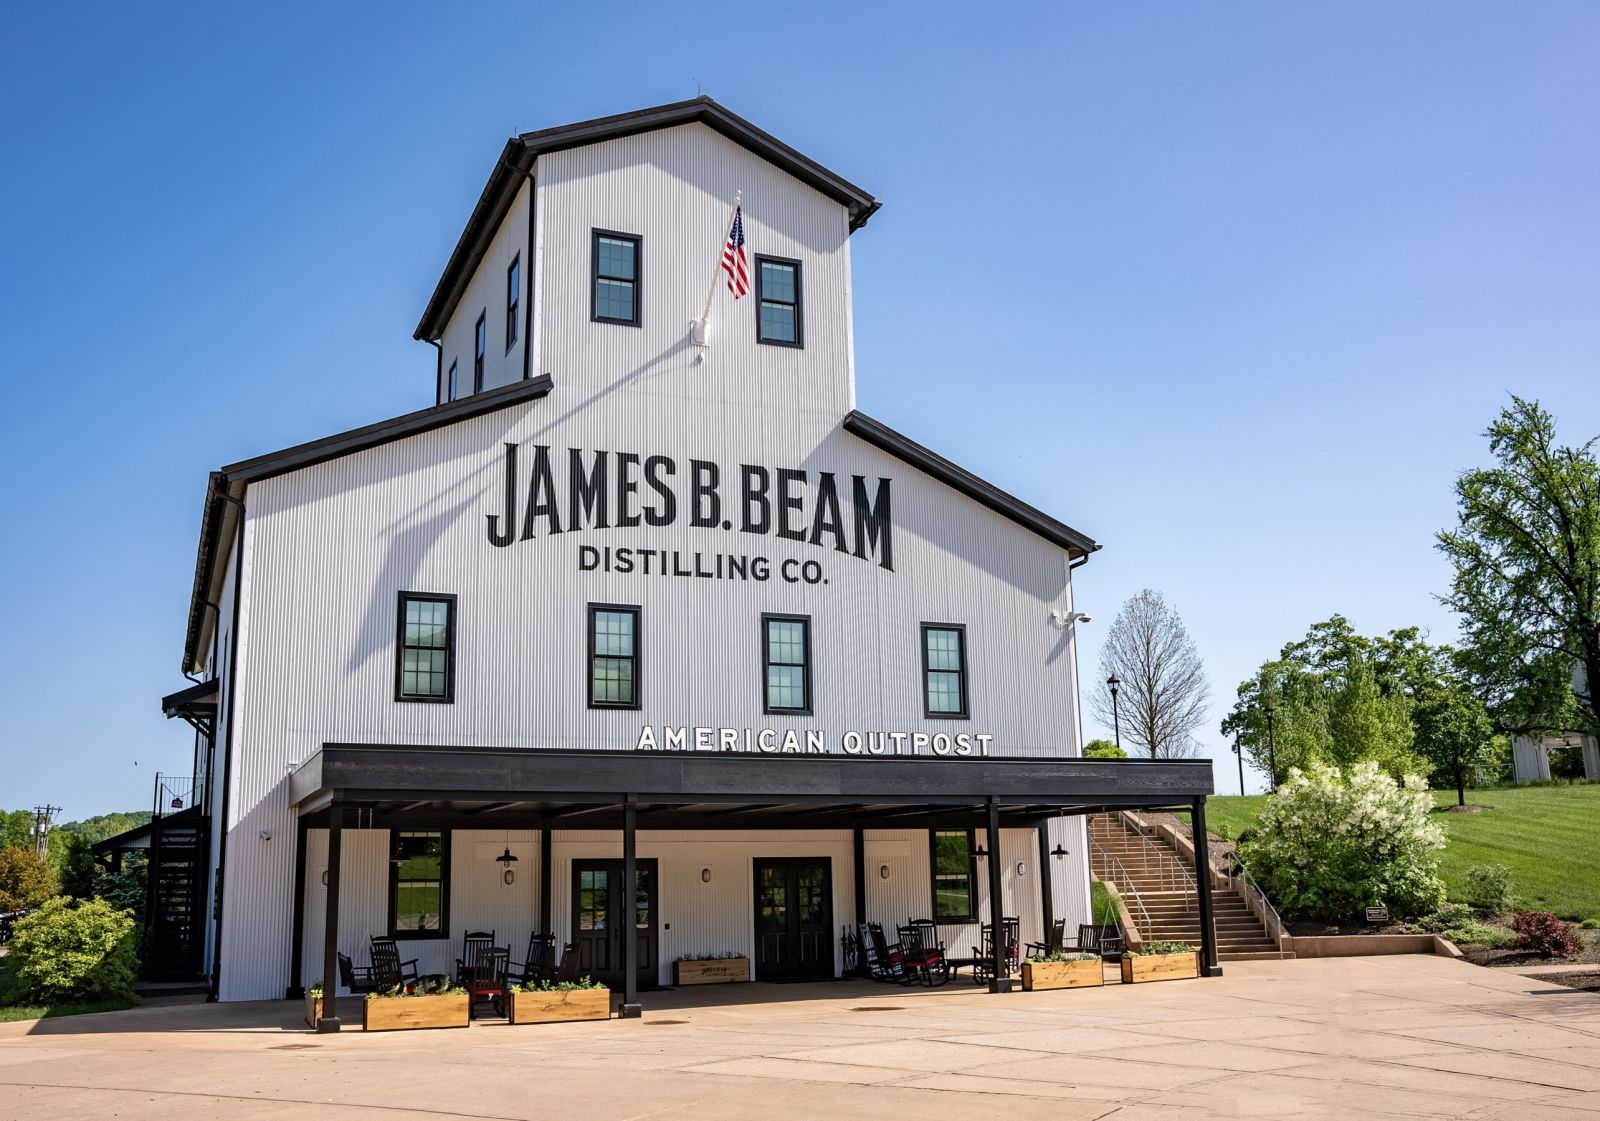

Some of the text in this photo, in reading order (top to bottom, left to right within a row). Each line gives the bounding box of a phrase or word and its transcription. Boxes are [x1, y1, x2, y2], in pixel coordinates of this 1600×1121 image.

[486, 442, 895, 573] JAMES B. BEAM
[578, 545, 829, 585] DISTILLING CO.
[635, 725, 993, 756] AMERICAN OUTPOST
